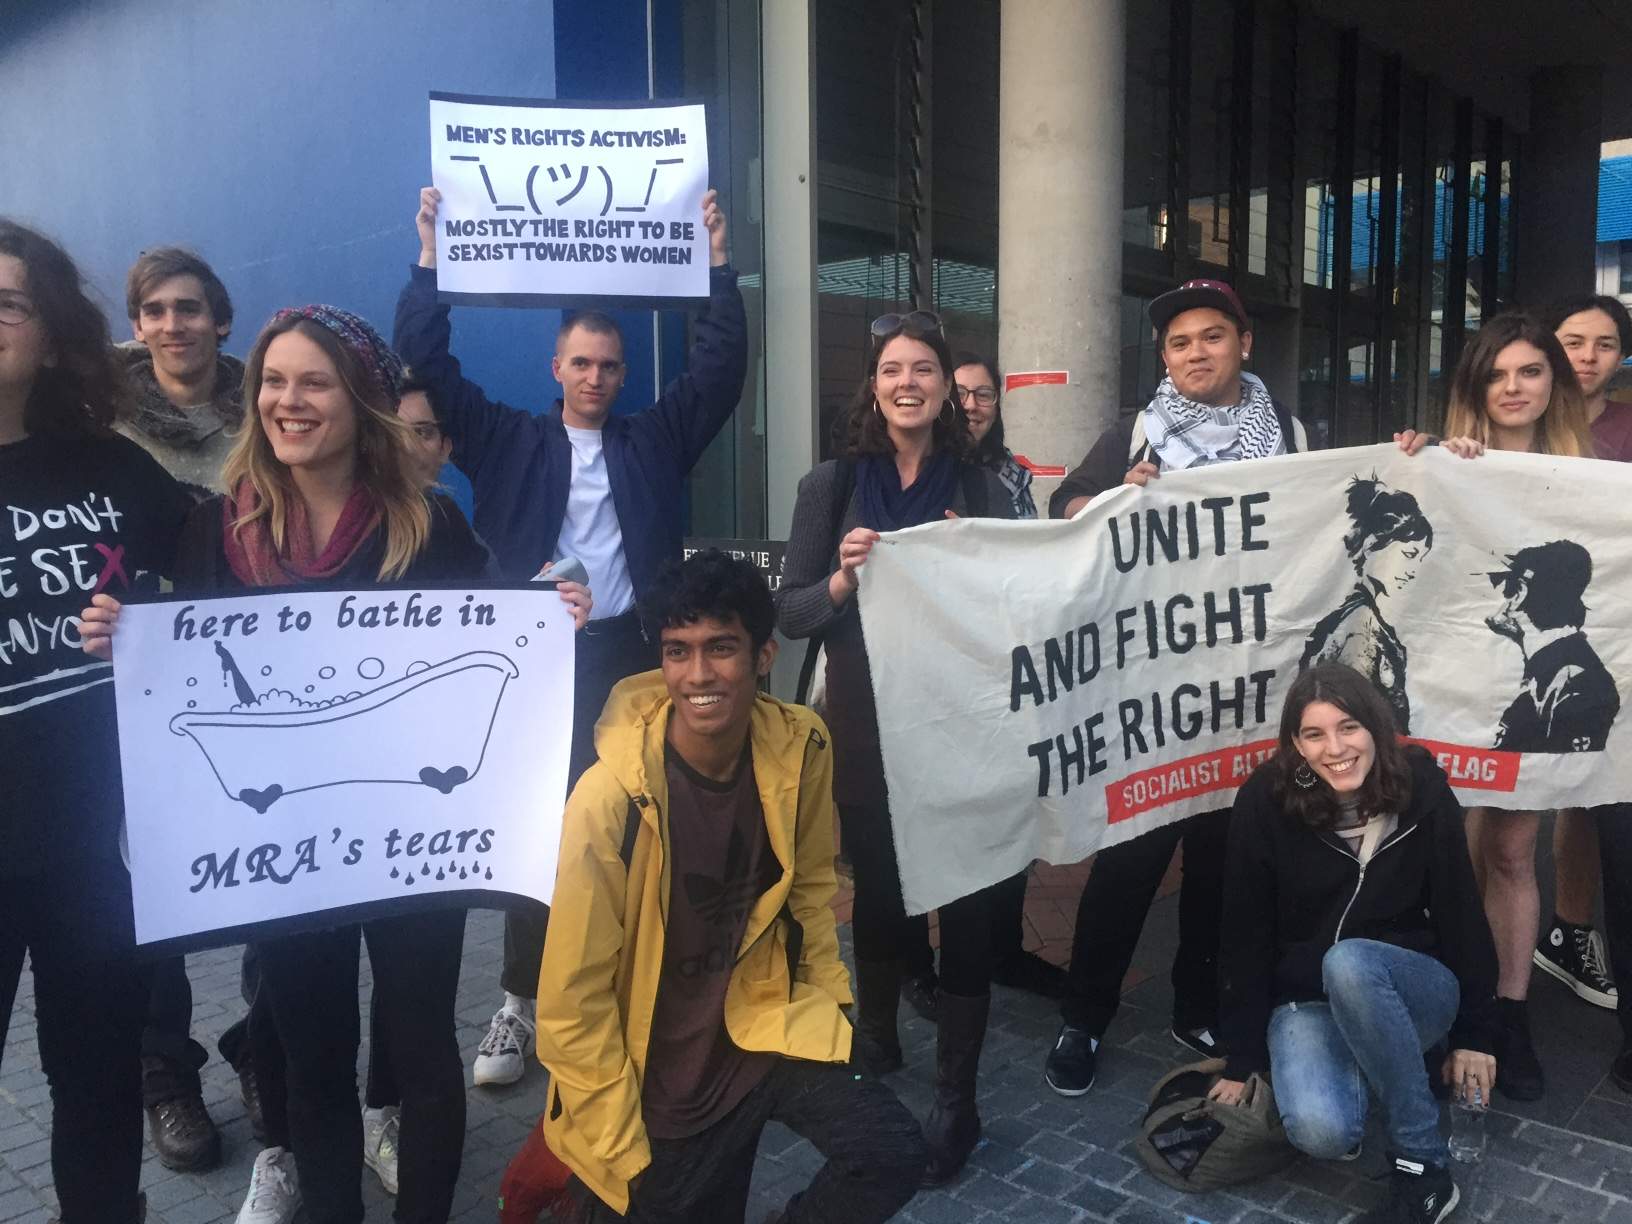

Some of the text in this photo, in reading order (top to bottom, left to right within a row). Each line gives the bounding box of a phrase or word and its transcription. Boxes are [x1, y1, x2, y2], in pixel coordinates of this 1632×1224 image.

[446, 124, 687, 148] MEN'S RIGHTS ACTIVISM:
[446, 218, 695, 241] MOSTLY THE RIGHT TO BE
[448, 242, 692, 265] SEXIST TOWARDS WOMEN
[1107, 491, 1270, 573] UNITE
[173, 595, 496, 640] here to bathe in
[1010, 583, 1273, 712] AND FIGHT
[1028, 669, 1276, 797] THE RIGHT
[1122, 759, 1221, 808] SOCIALIST
[190, 827, 495, 893] MRA's tears
